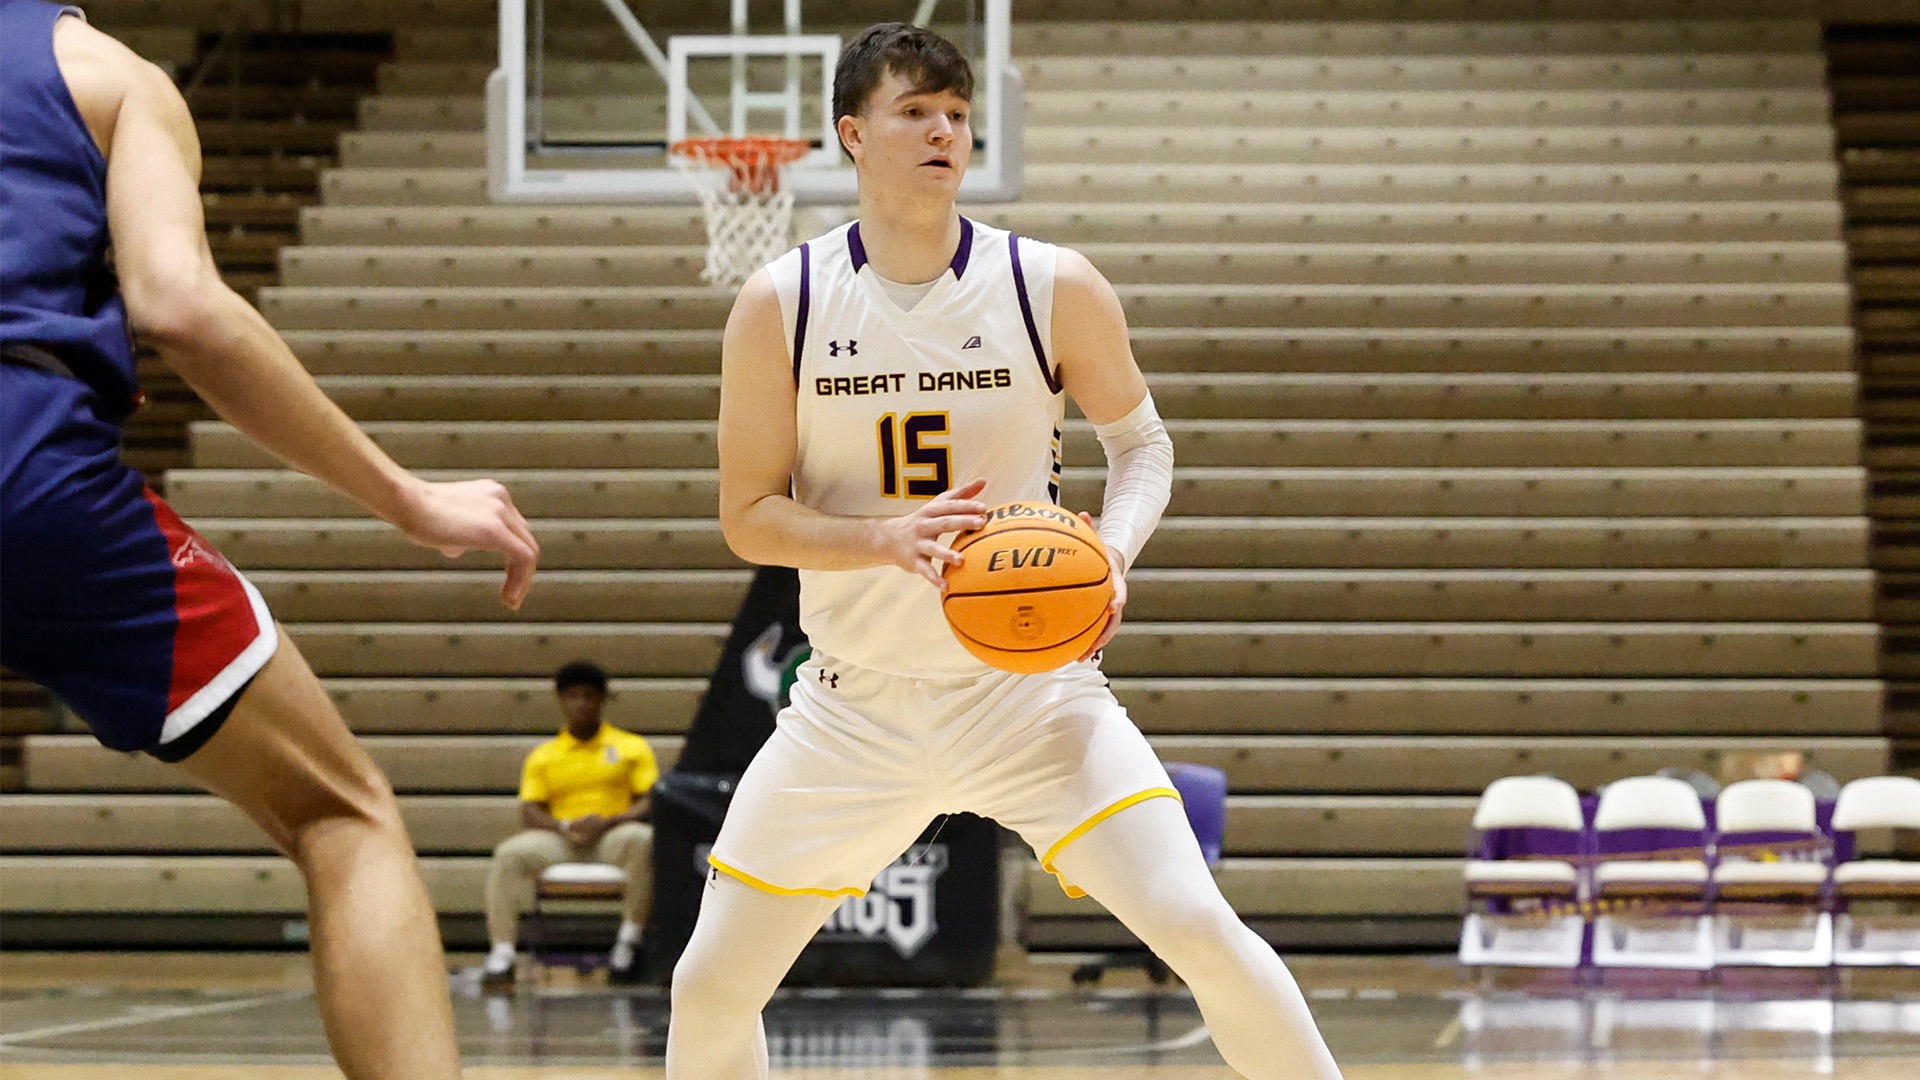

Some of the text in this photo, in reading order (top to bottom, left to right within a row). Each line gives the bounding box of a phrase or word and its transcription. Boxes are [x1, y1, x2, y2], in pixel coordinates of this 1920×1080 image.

[815, 368, 1012, 396] GREAT DANES
[875, 410, 953, 499] 15
[984, 504, 1077, 529] ilson
[987, 547, 1056, 572] EVO
